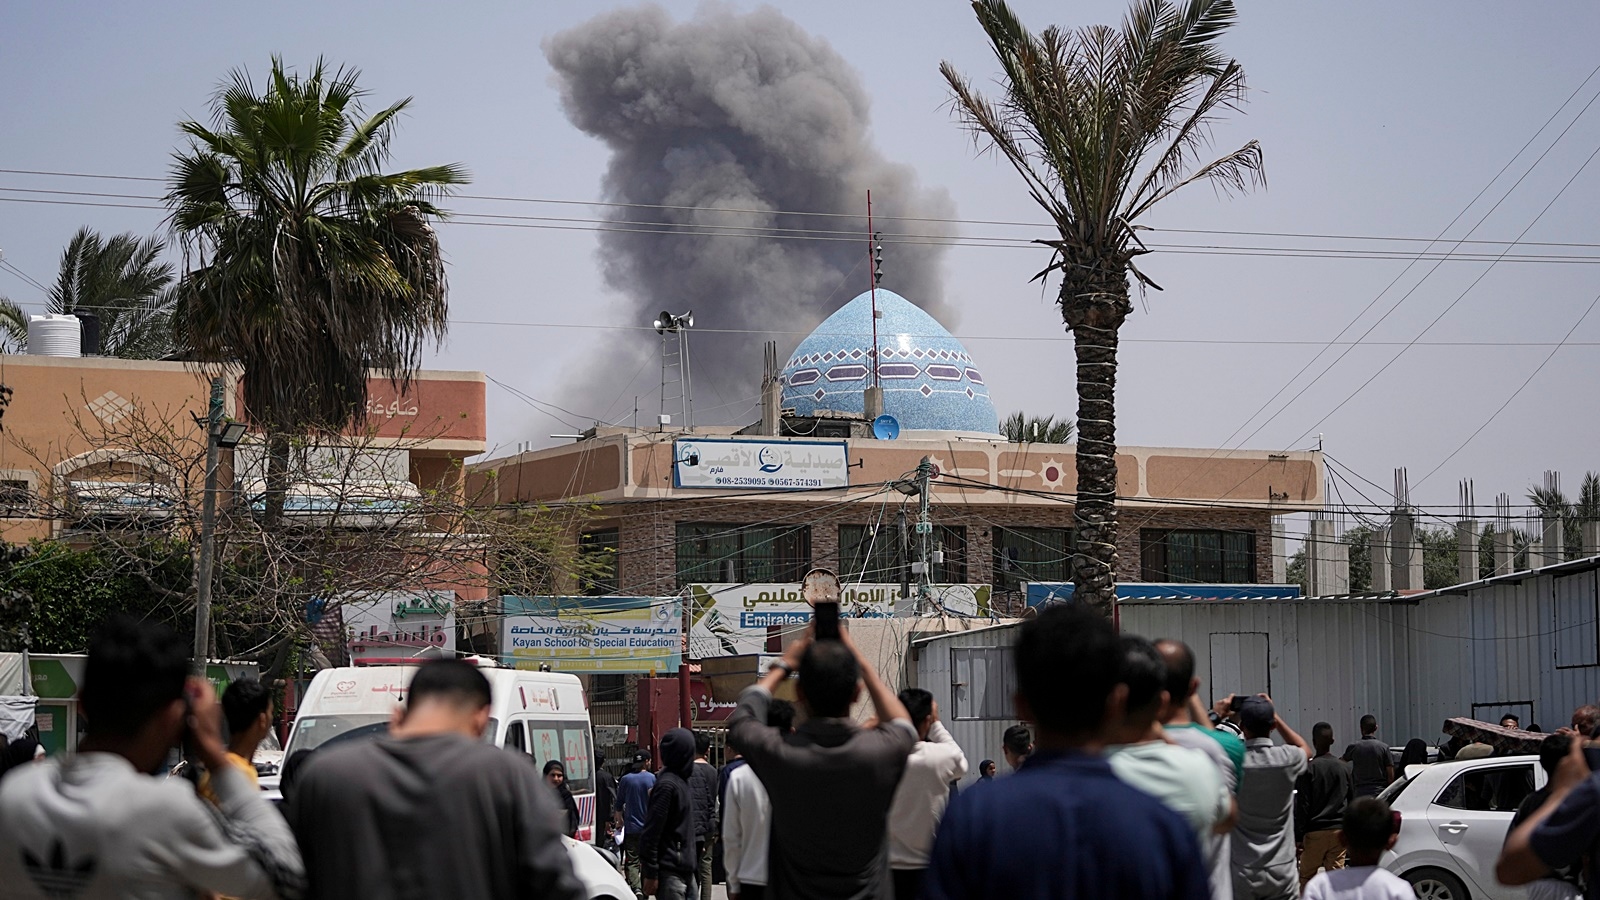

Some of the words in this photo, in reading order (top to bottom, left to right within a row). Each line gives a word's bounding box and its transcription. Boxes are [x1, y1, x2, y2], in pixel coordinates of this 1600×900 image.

[698, 446, 757, 471] الأقصى
[784, 450, 843, 474] صيدلية
[709, 466, 724, 475] فارم
[722, 477, 766, 486] 08-2539095
[774, 478, 822, 487] 0567-574391
[744, 613, 804, 627] Emirates
[632, 626, 677, 637] مدرسة
[512, 637, 542, 649] Kayan
[544, 637, 576, 647] School
[578, 637, 590, 647] for
[593, 637, 627, 649] Special
[629, 637, 675, 647] Education
